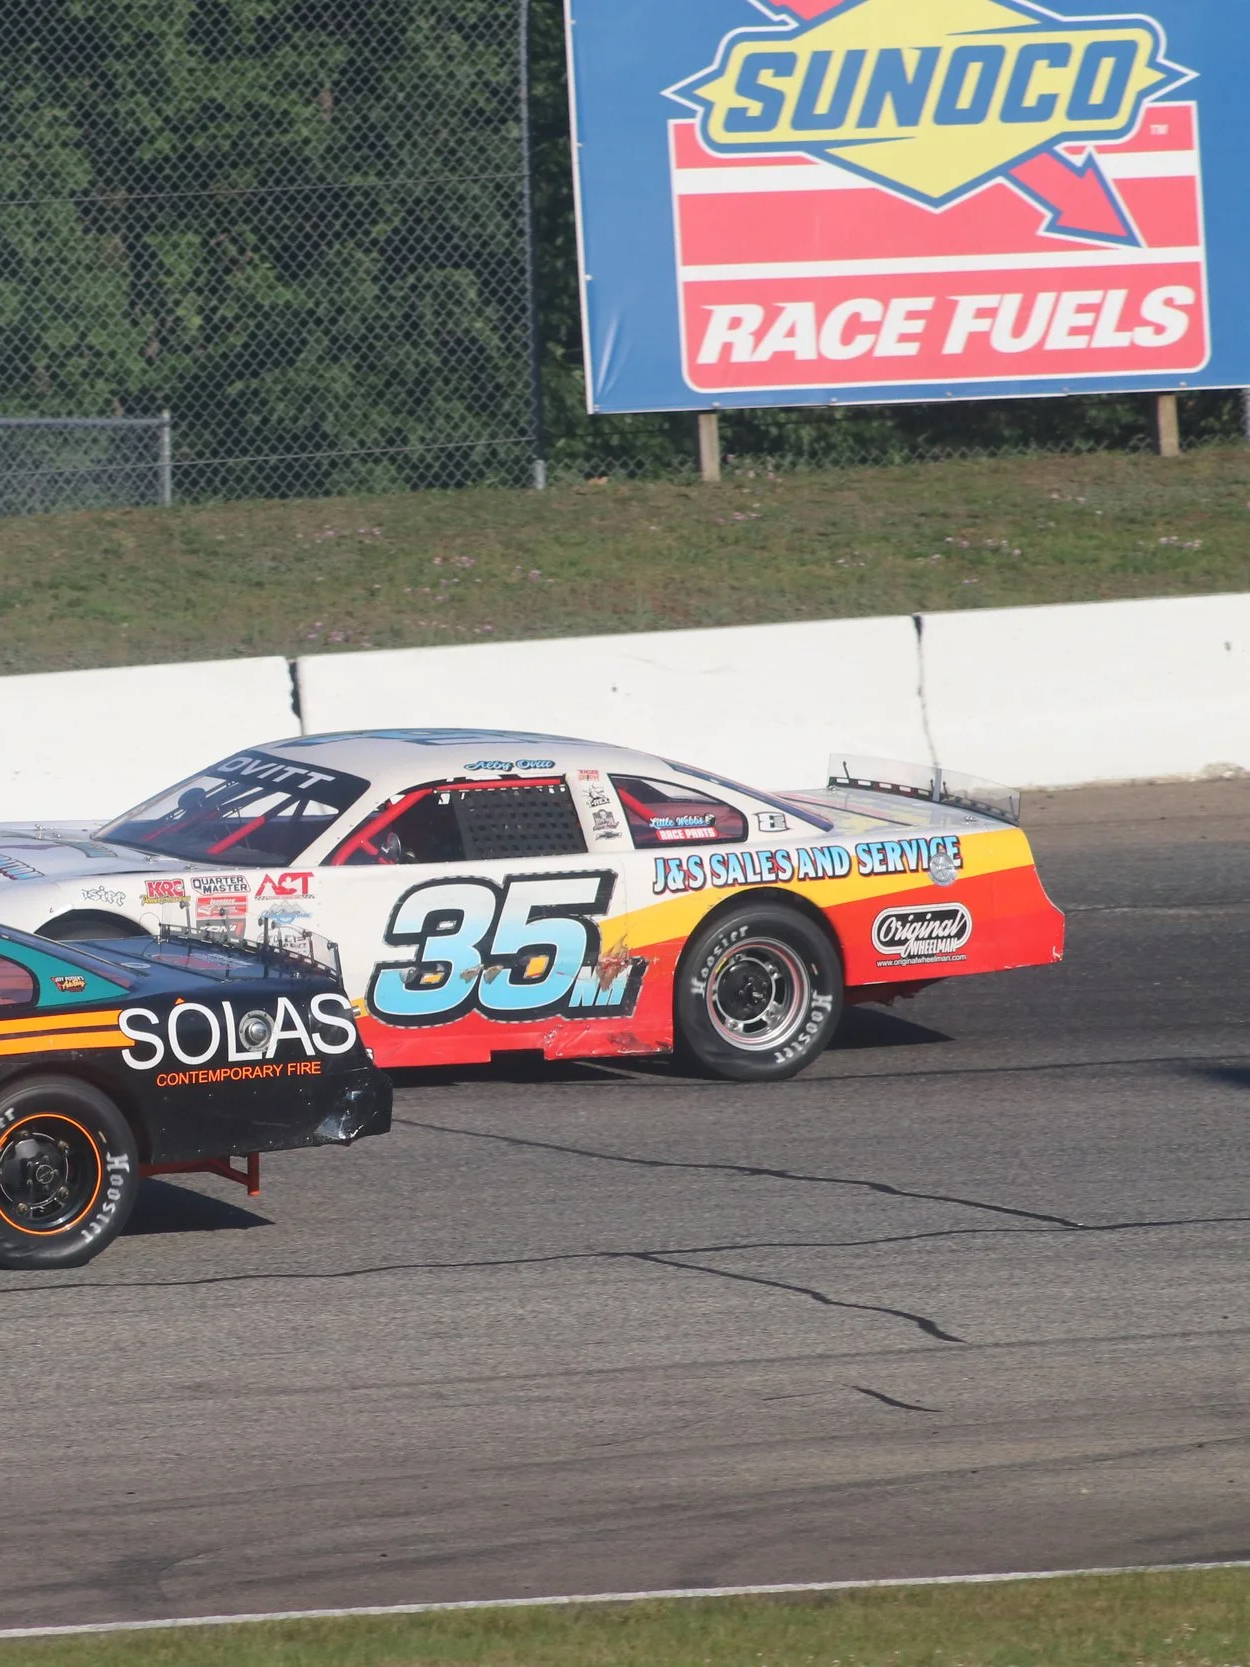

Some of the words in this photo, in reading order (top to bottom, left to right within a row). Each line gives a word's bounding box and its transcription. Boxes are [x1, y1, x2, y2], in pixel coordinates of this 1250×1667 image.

[722, 39, 1140, 134] SUNOCO
[696, 296, 936, 364] RACE
[941, 284, 1196, 356] FUELS
[217, 756, 336, 789] OVITT
[660, 829, 684, 840] RACE
[686, 828, 716, 838] PARTS
[193, 877, 244, 888] QUARTER
[203, 883, 248, 894] MASTER
[652, 855, 705, 895] J&S
[710, 849, 794, 888] SALES
[797, 844, 851, 881] AND
[374, 877, 601, 1016] 35
[879, 909, 966, 957] Original
[909, 937, 958, 956] WHEELMAN
[118, 993, 357, 1070] SOLAS
[156, 1064, 283, 1087] CONTEMPORARY
[287, 1062, 322, 1076] FIRE
